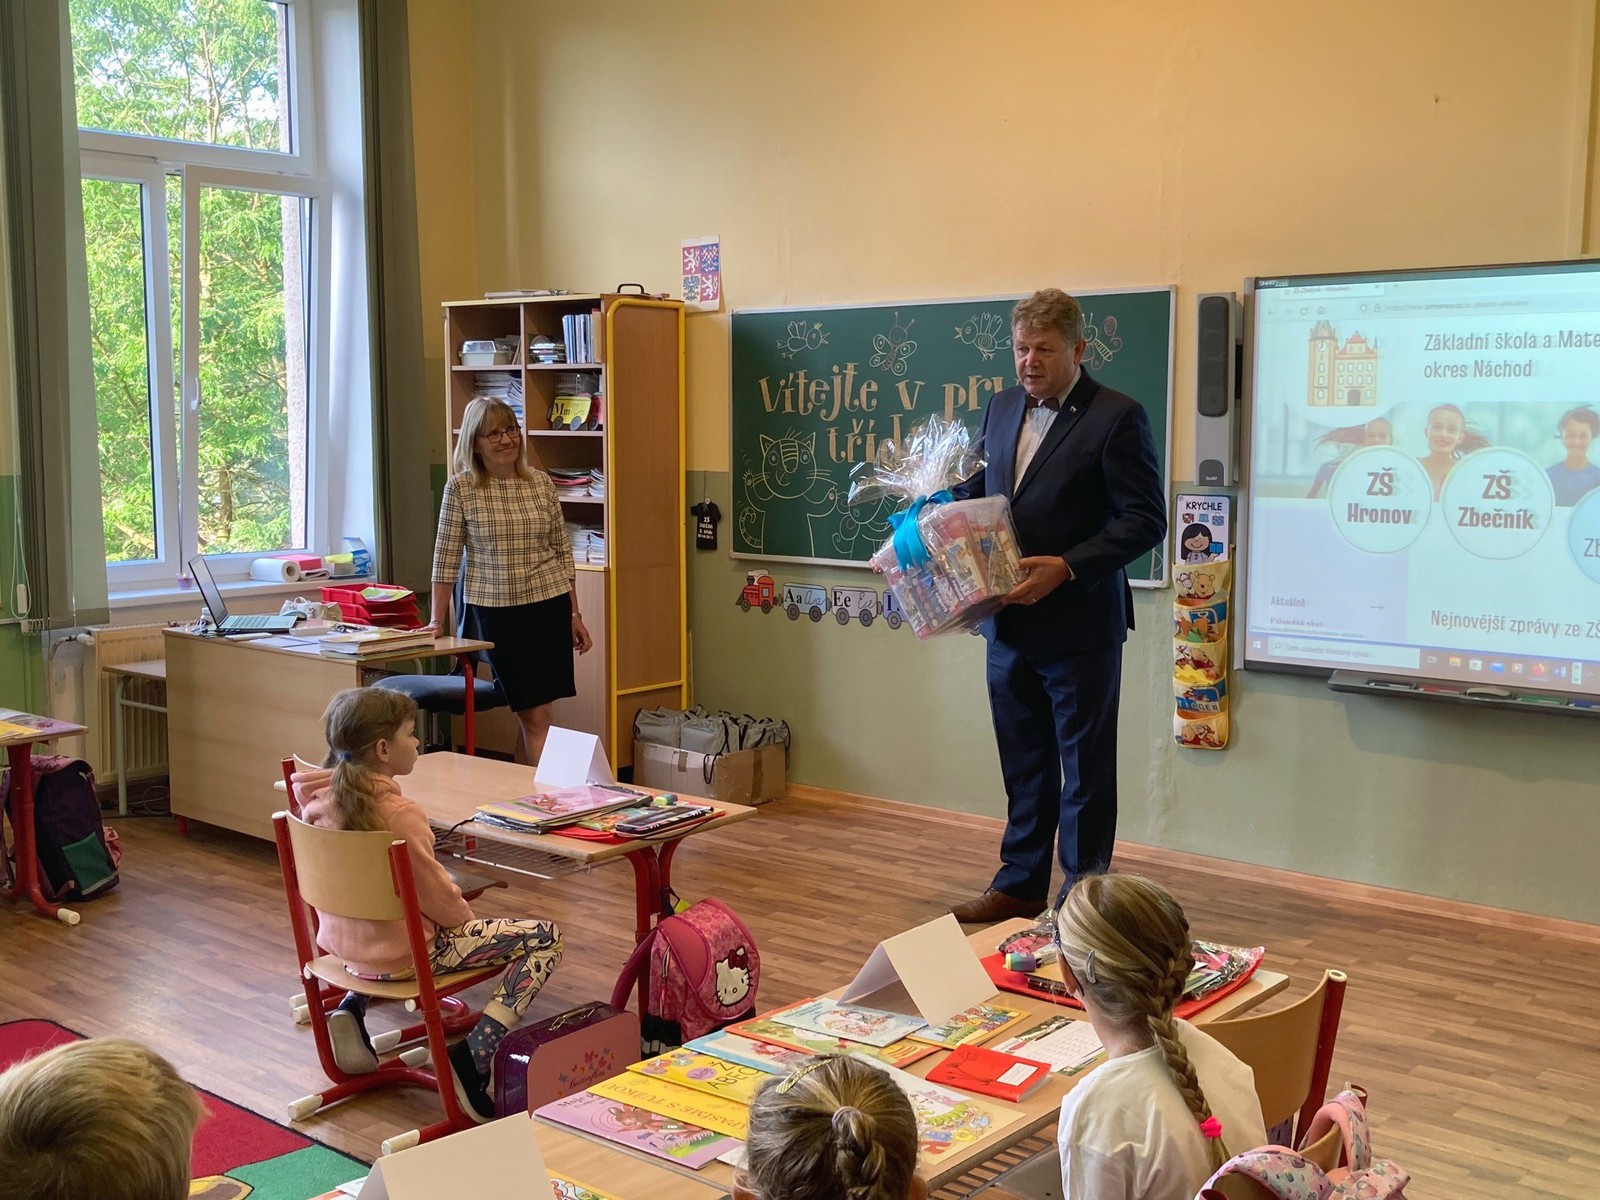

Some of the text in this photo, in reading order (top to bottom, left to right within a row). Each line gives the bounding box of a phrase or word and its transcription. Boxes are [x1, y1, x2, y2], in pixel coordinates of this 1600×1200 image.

[1424, 330, 1600, 351] Základní škola a Mate
[1424, 359, 1533, 379] okres Náchod
[758, 363, 879, 421] Vítejte
[826, 413, 906, 465] tříd
[1366, 467, 1394, 496] ZŠ
[1482, 469, 1512, 500] ZŠ
[1185, 501, 1223, 511] KRYCHLE
[1347, 502, 1412, 524] Hronov
[1457, 506, 1535, 530] Zbečník
[784, 588, 803, 604] Aa
[833, 591, 851, 608] Ee
[1431, 610, 1505, 634] Nejnovější
[1509, 618, 1559, 638] zprávy
[1564, 623, 1581, 637] ze
